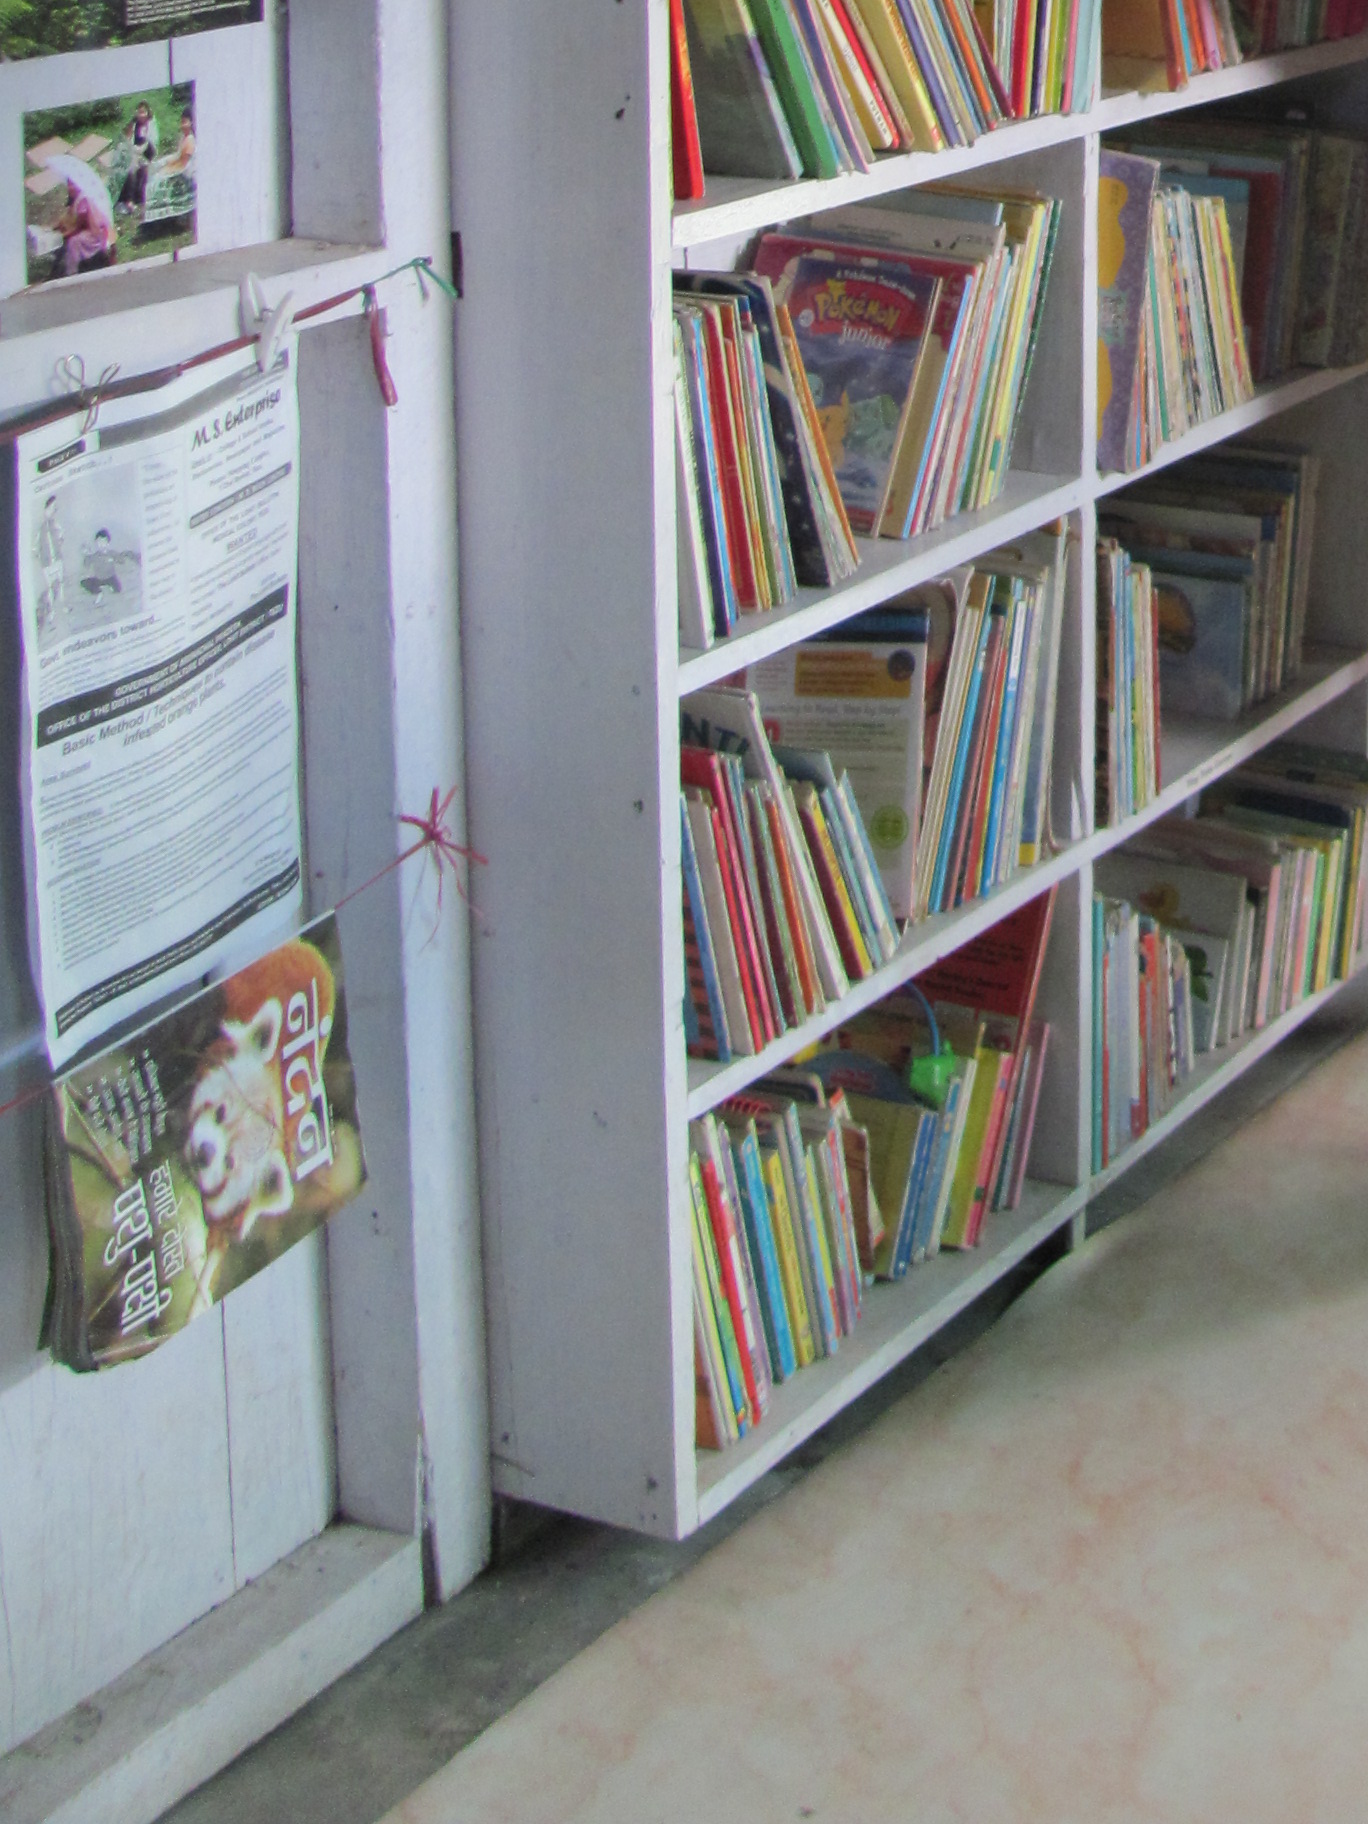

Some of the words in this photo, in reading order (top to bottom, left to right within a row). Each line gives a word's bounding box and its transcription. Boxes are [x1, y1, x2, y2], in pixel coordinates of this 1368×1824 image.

[62, 734, 97, 757] Basic
[99, 716, 145, 743] Method
[281, 976, 335, 1183] नंदन
